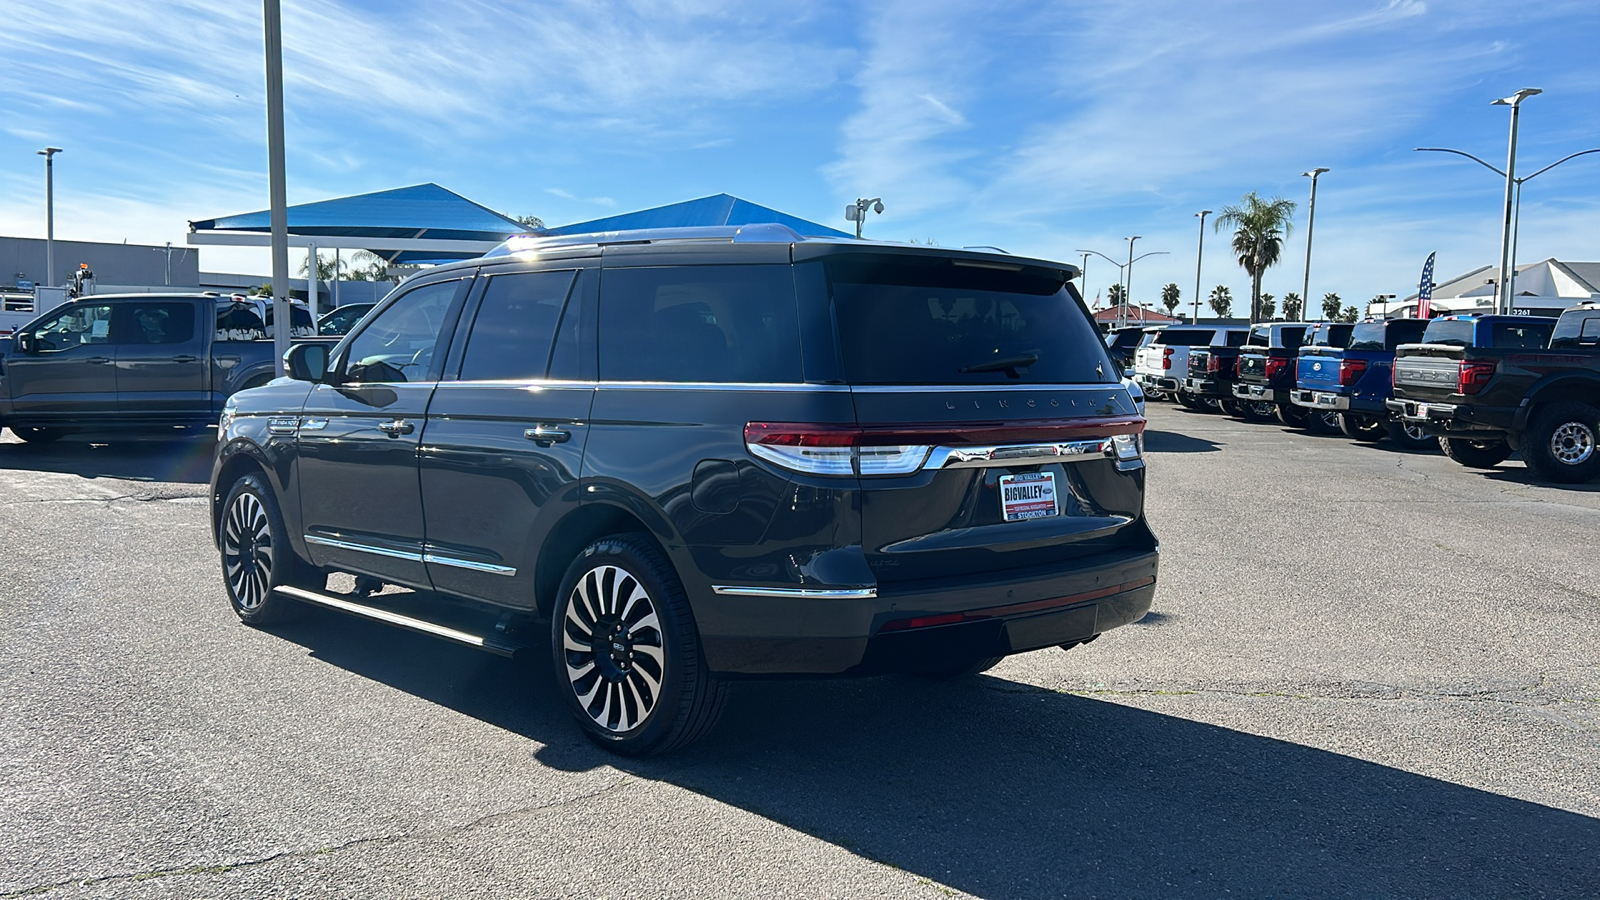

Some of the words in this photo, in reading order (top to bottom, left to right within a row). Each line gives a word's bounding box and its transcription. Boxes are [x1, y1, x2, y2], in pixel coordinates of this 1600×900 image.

[945, 399, 1097, 410] LINCOLN
[1005, 485, 1042, 501] BIGVALLEY
[1017, 510, 1047, 519] STOCKTON
